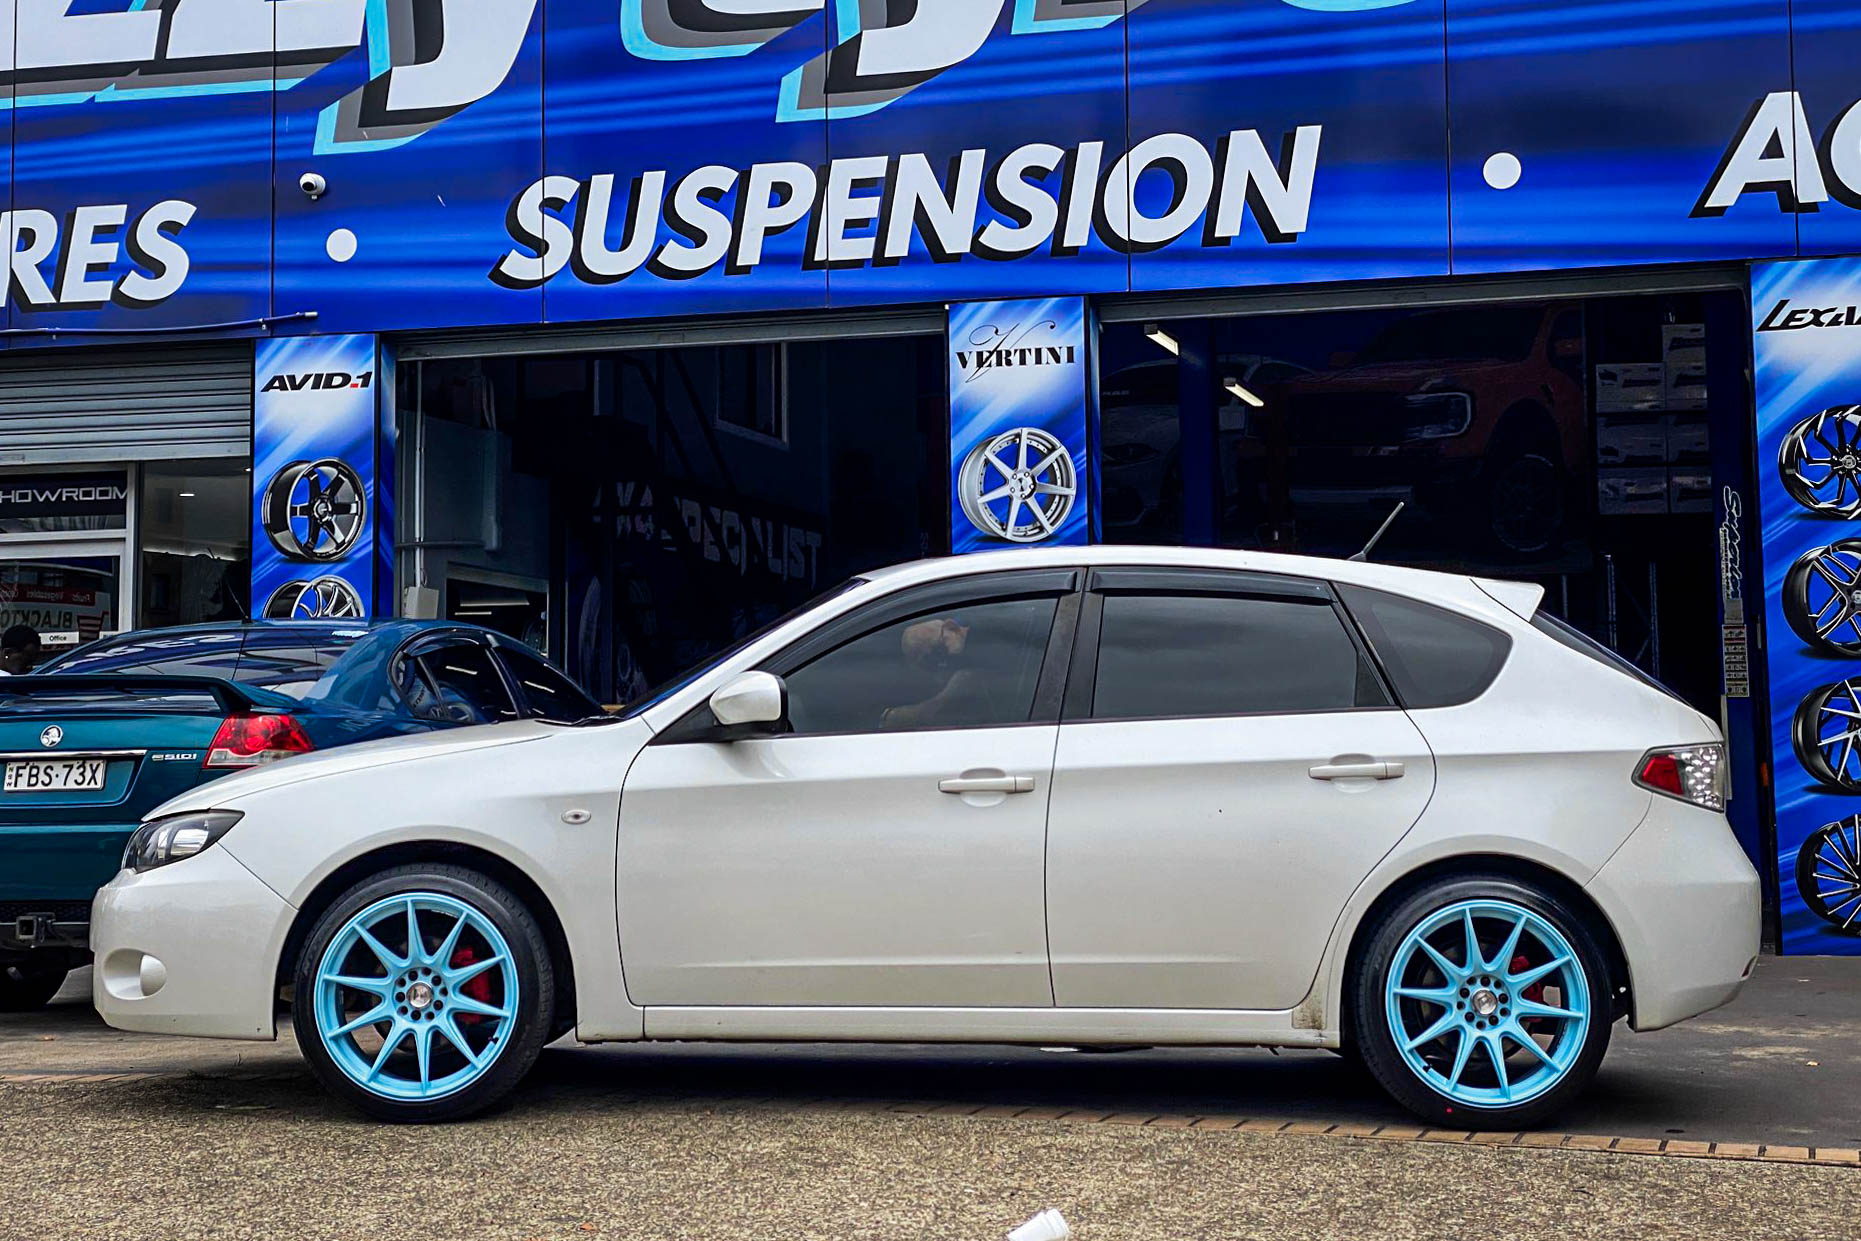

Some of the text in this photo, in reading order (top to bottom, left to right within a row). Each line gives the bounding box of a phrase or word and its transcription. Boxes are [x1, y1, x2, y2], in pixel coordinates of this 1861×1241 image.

[492, 125, 1322, 286] SUSPENSION
[955, 345, 1076, 370] VERTINI
[260, 371, 373, 393] AVID.1
[0, 486, 128, 503] HOWROOM
[48, 635, 68, 643] Office
